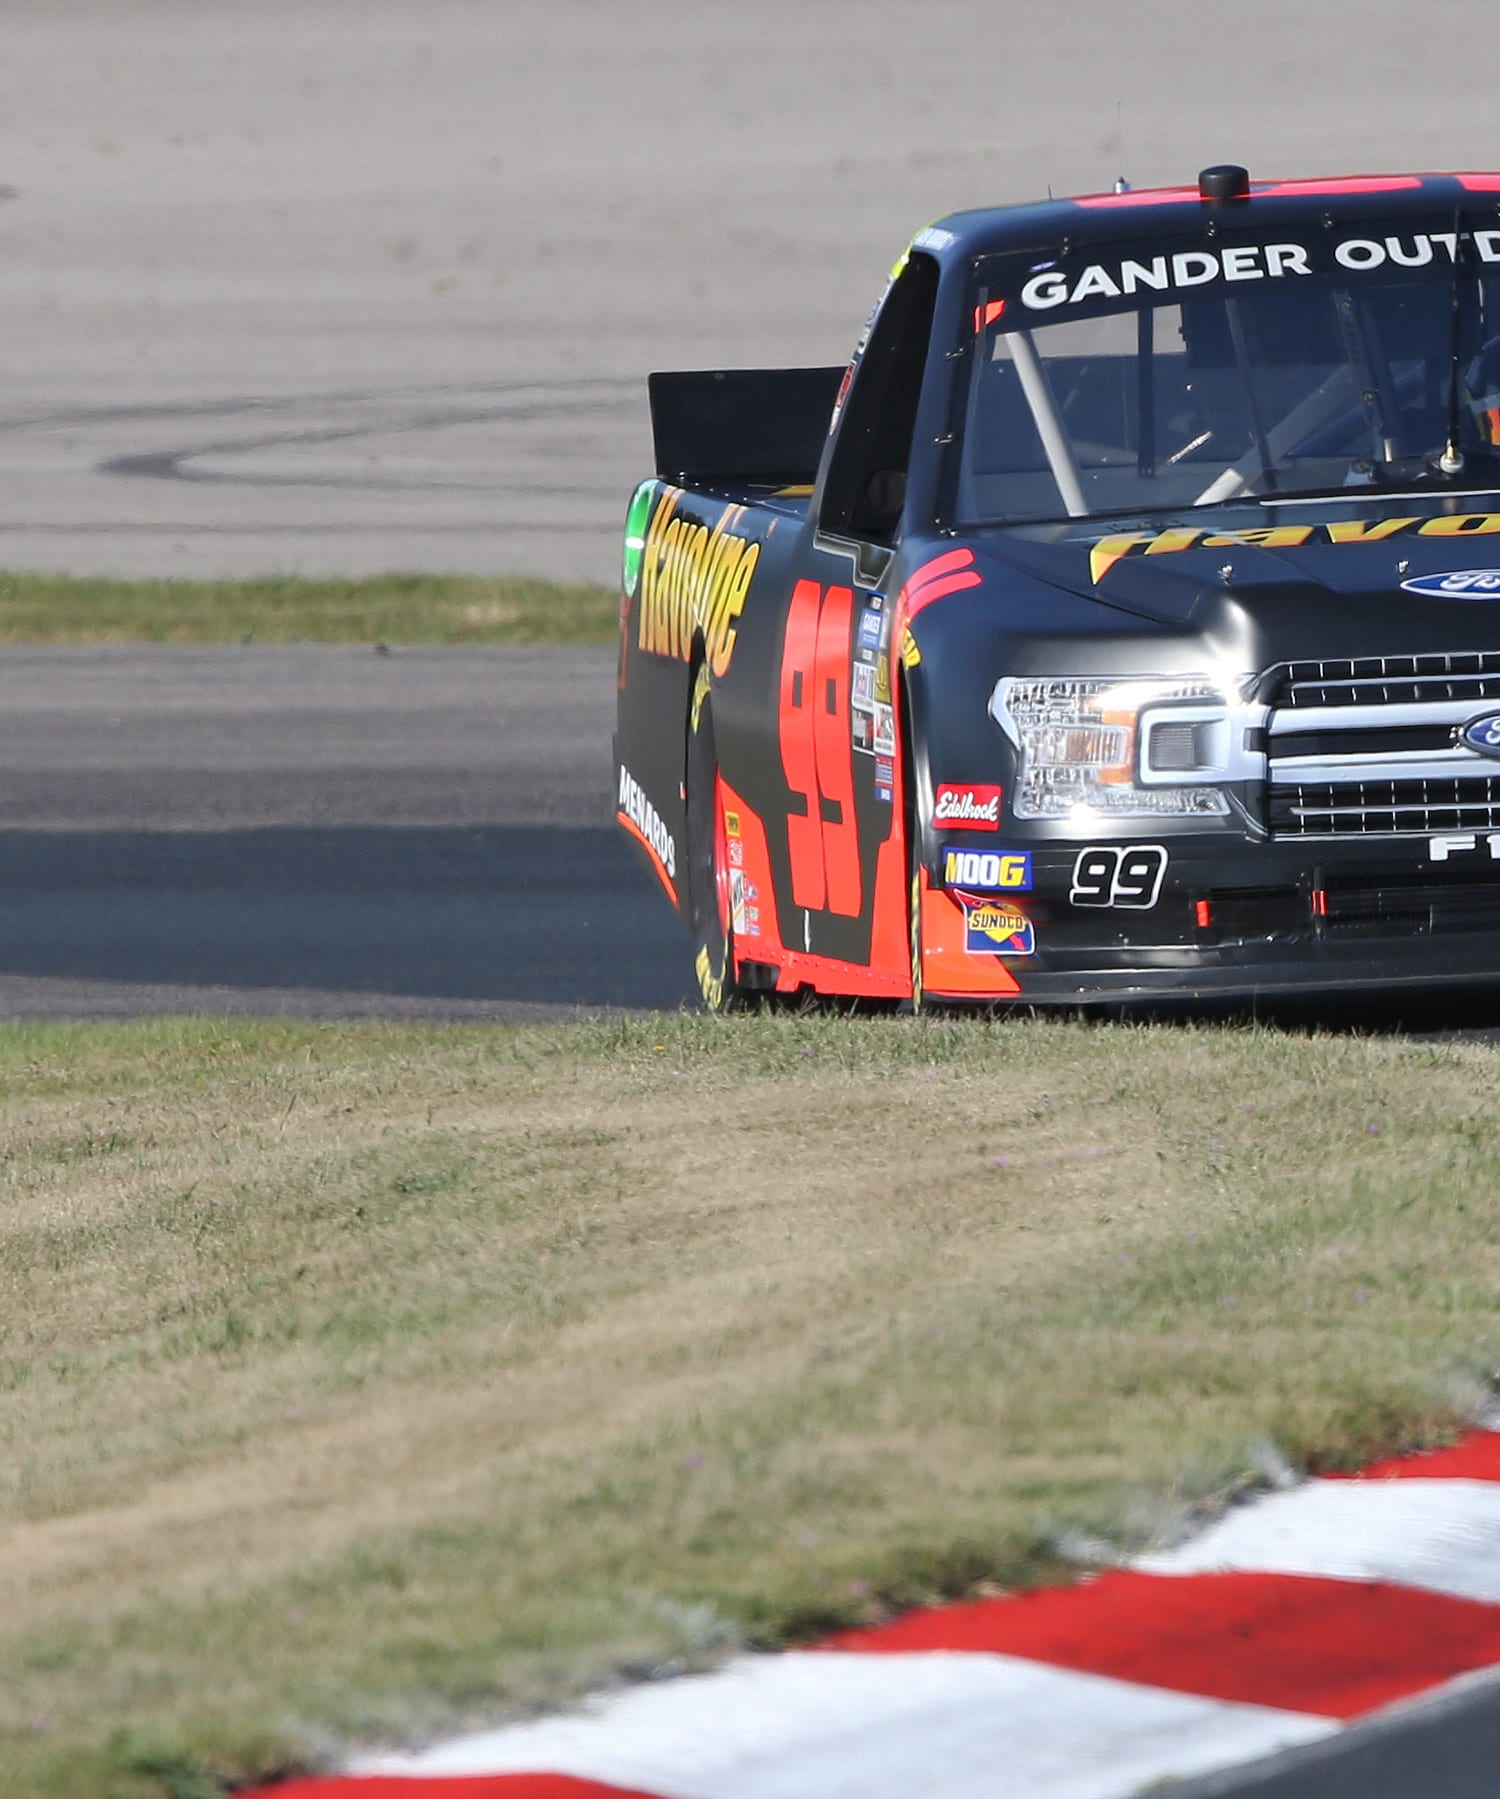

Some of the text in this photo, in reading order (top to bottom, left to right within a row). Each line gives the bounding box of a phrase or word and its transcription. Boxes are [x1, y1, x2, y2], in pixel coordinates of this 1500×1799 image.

[1020, 242, 1312, 310] GANDER
[638, 485, 762, 678] Havoline
[778, 579, 863, 918] 99
[617, 763, 676, 879] MENARDS
[935, 790, 999, 823] Edelbrock
[945, 851, 1027, 888] MOOG
[1069, 844, 1169, 911] 99
[972, 911, 1024, 931] SUNOCO
